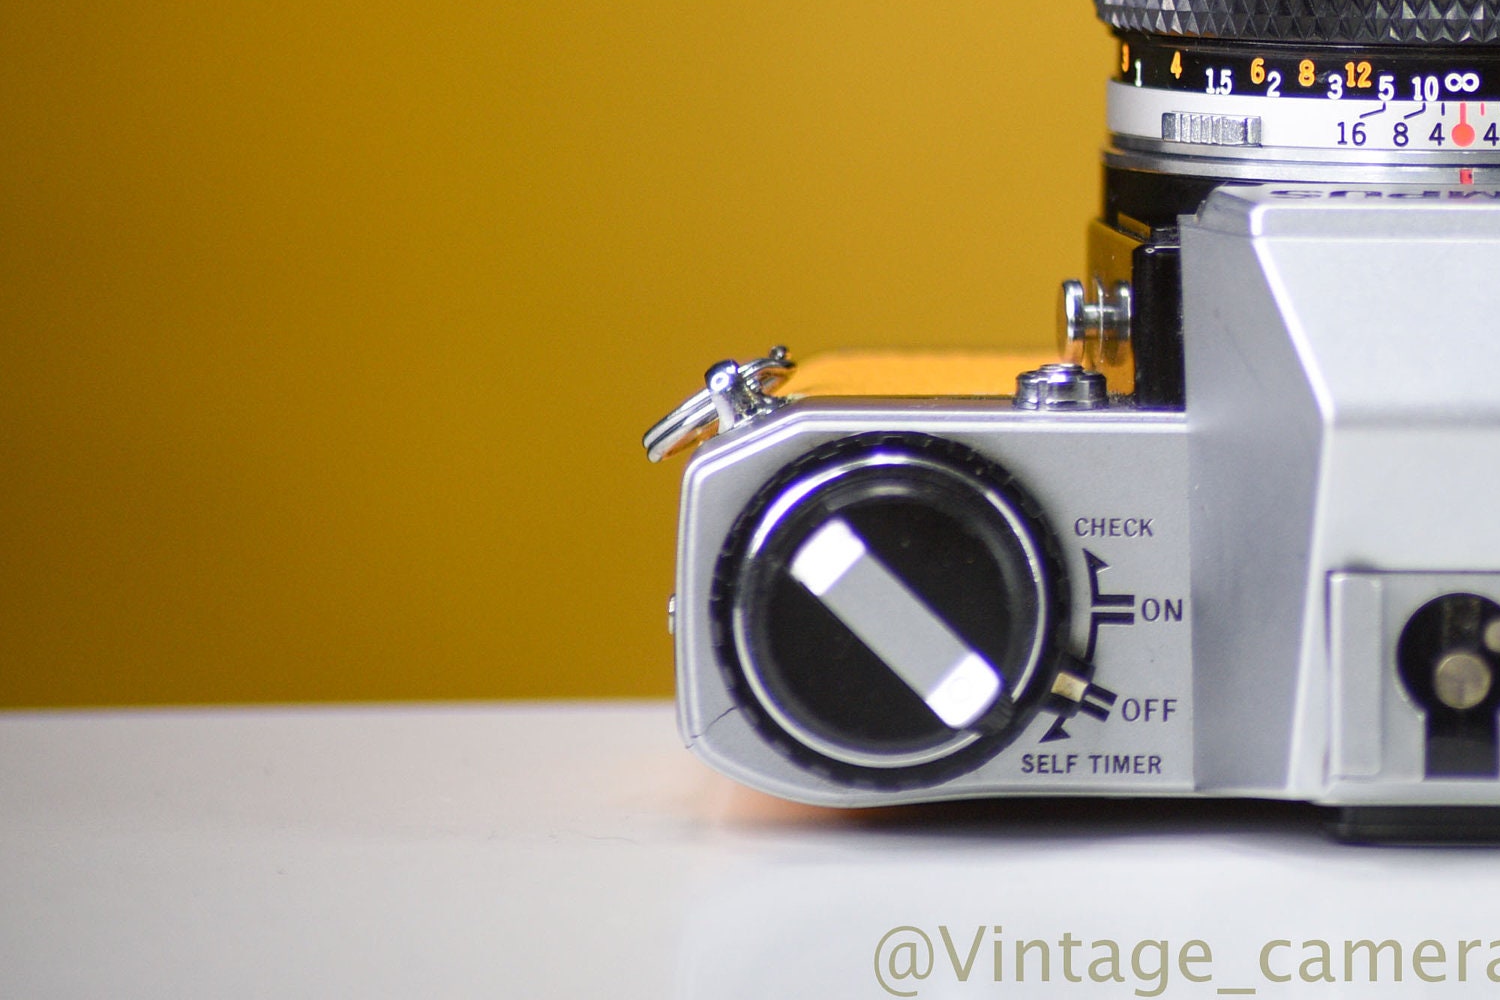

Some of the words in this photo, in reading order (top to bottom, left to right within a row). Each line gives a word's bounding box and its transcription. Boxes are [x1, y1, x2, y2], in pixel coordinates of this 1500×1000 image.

[1134, 60, 1143, 88] 1
[1205, 67, 1233, 96] 1.5
[1263, 70, 1282, 98] 2
[1326, 73, 1343, 100] 3
[1377, 75, 1395, 101] 5
[1411, 75, 1440, 102] 10
[1170, 51, 1183, 80] 4
[1250, 57, 1265, 85] 6
[1298, 59, 1315, 87] 8
[1344, 61, 1372, 89] 12
[1337, 121, 1367, 147] 16
[1392, 121, 1409, 148] 8
[1428, 122, 1446, 147] 4
[1482, 122, 1500, 147] 4
[1073, 517, 1153, 537] CHECK
[1141, 598, 1183, 622] ON
[1121, 698, 1177, 722] OFF
[1021, 753, 1079, 774] SELF
[1087, 754, 1162, 774] TIMER
